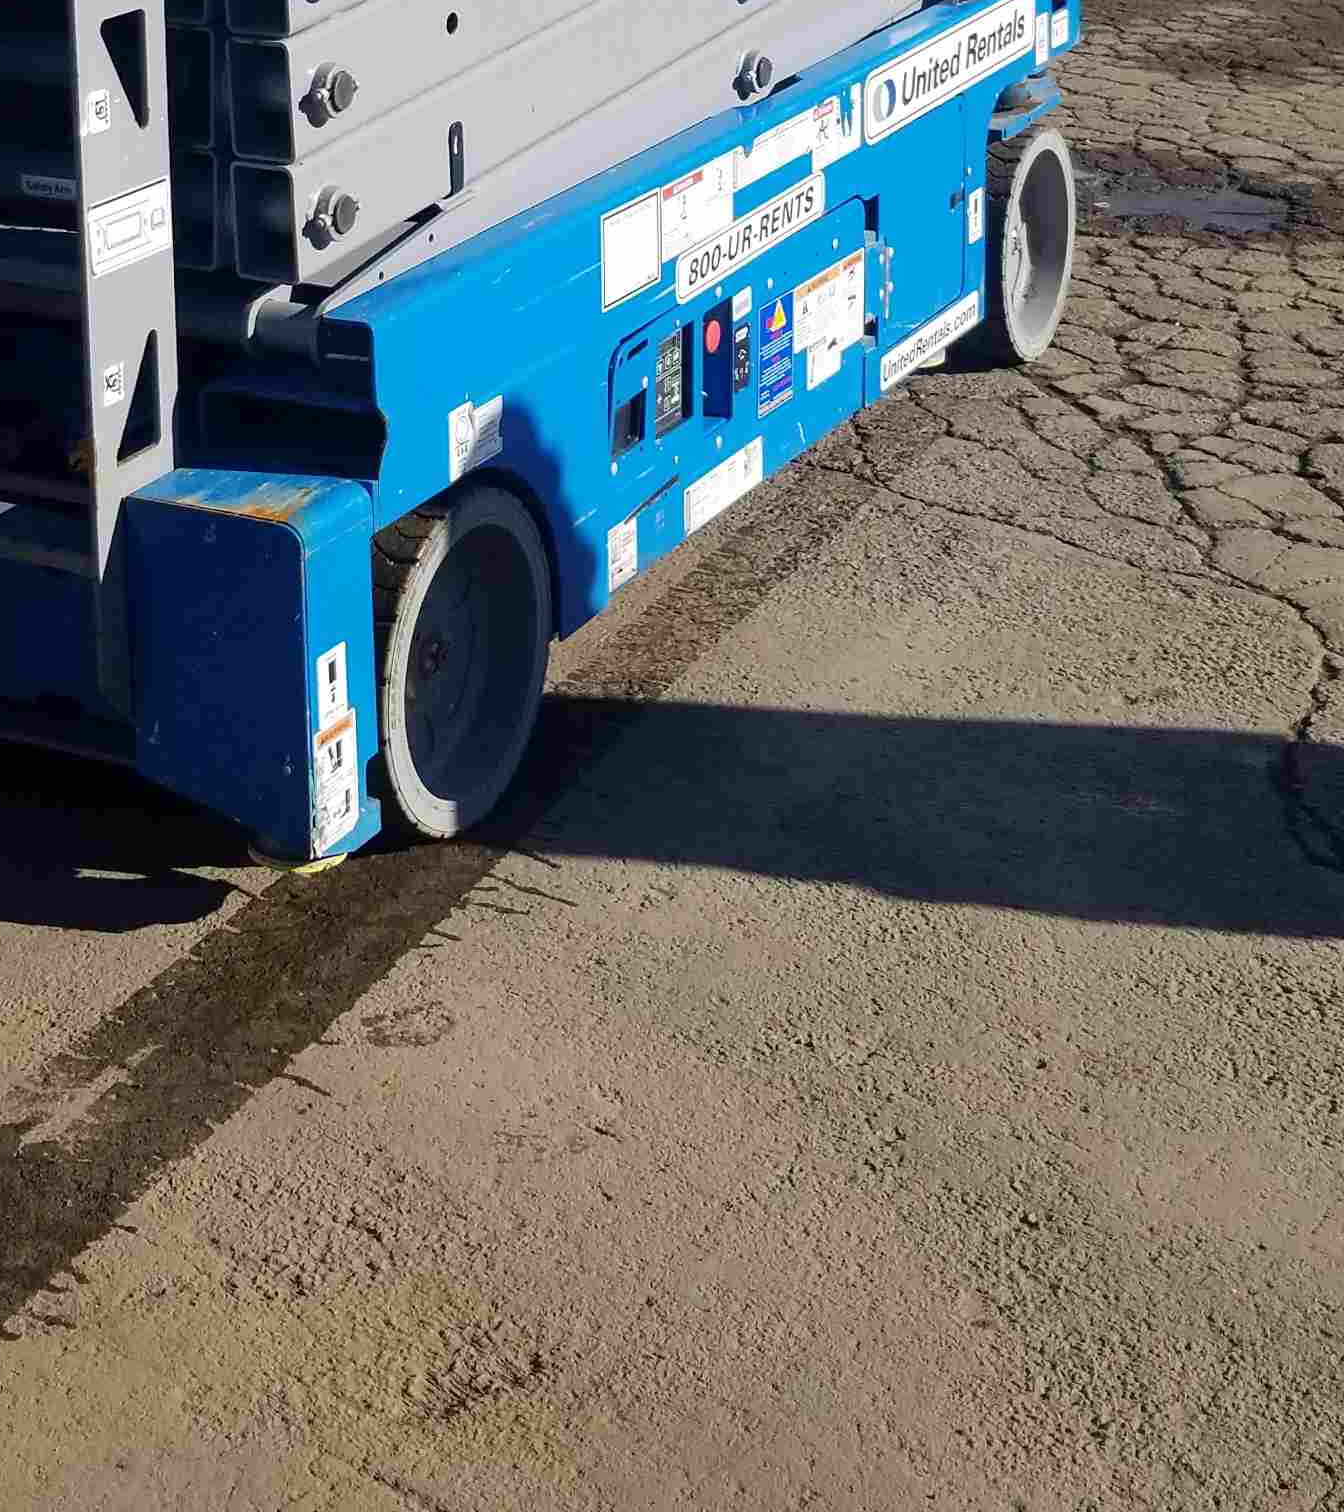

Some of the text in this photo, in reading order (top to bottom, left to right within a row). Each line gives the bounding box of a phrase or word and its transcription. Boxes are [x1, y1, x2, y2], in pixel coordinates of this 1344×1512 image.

[901, 9, 1025, 106] United Rentals
[688, 185, 814, 287] 800-UR-RENTS
[883, 303, 976, 382] UnitedRentals.com
